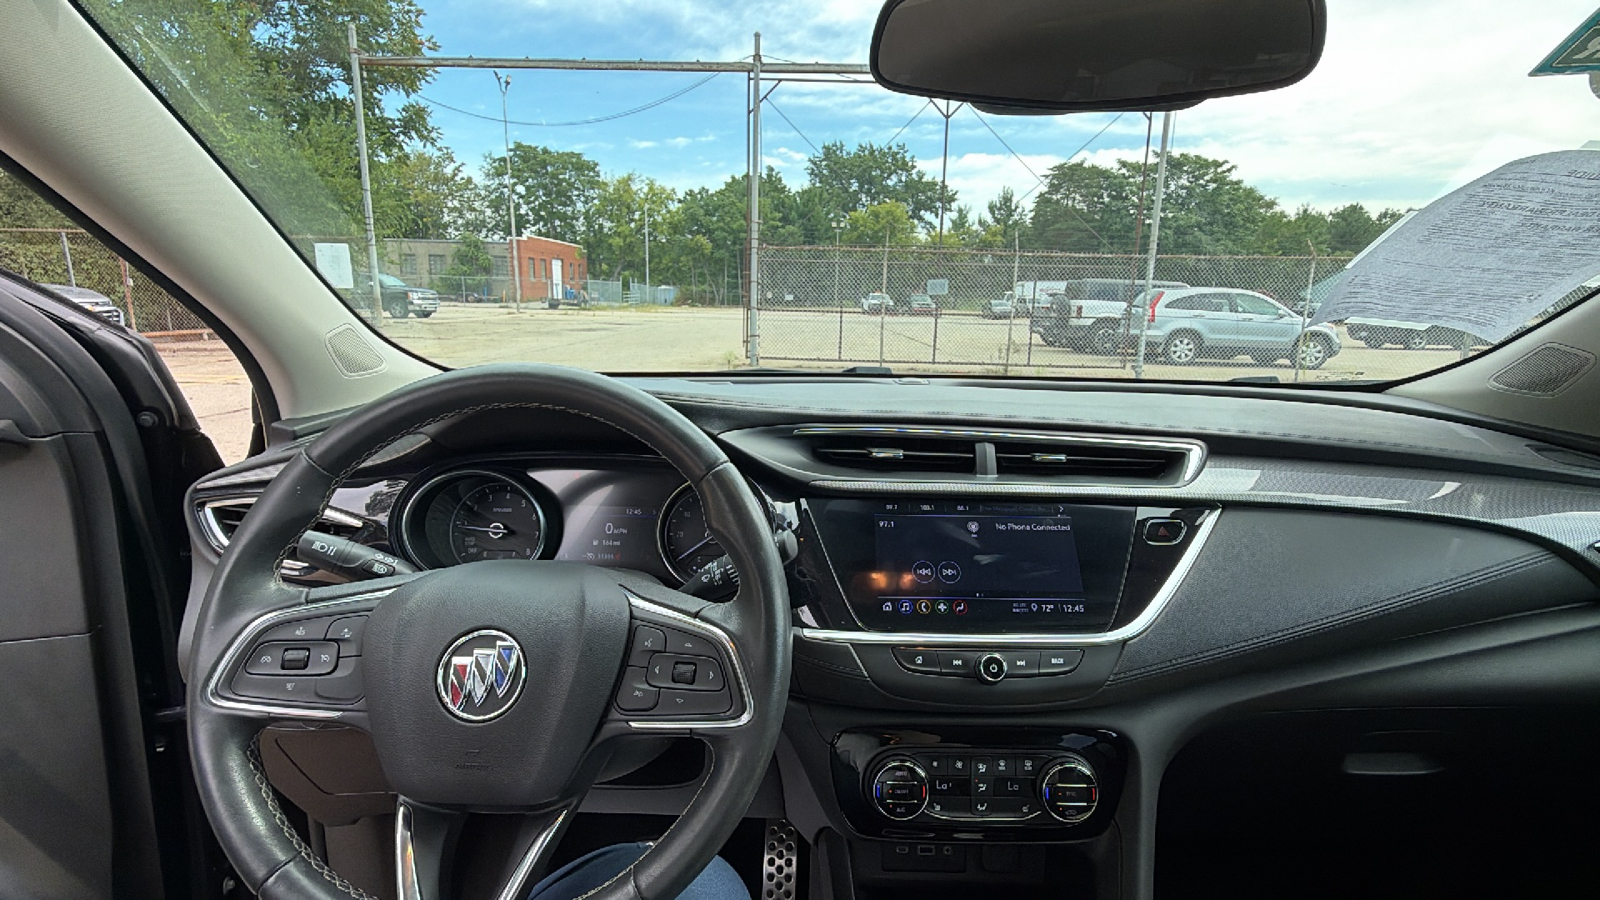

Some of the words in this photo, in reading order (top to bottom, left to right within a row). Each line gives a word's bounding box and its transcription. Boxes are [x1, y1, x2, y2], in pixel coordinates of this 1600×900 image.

[878, 520, 895, 528] 97.1
[1007, 523, 1031, 531] Phone
[604, 522, 614, 535] 0
[1063, 604, 1085, 613] 12:45
